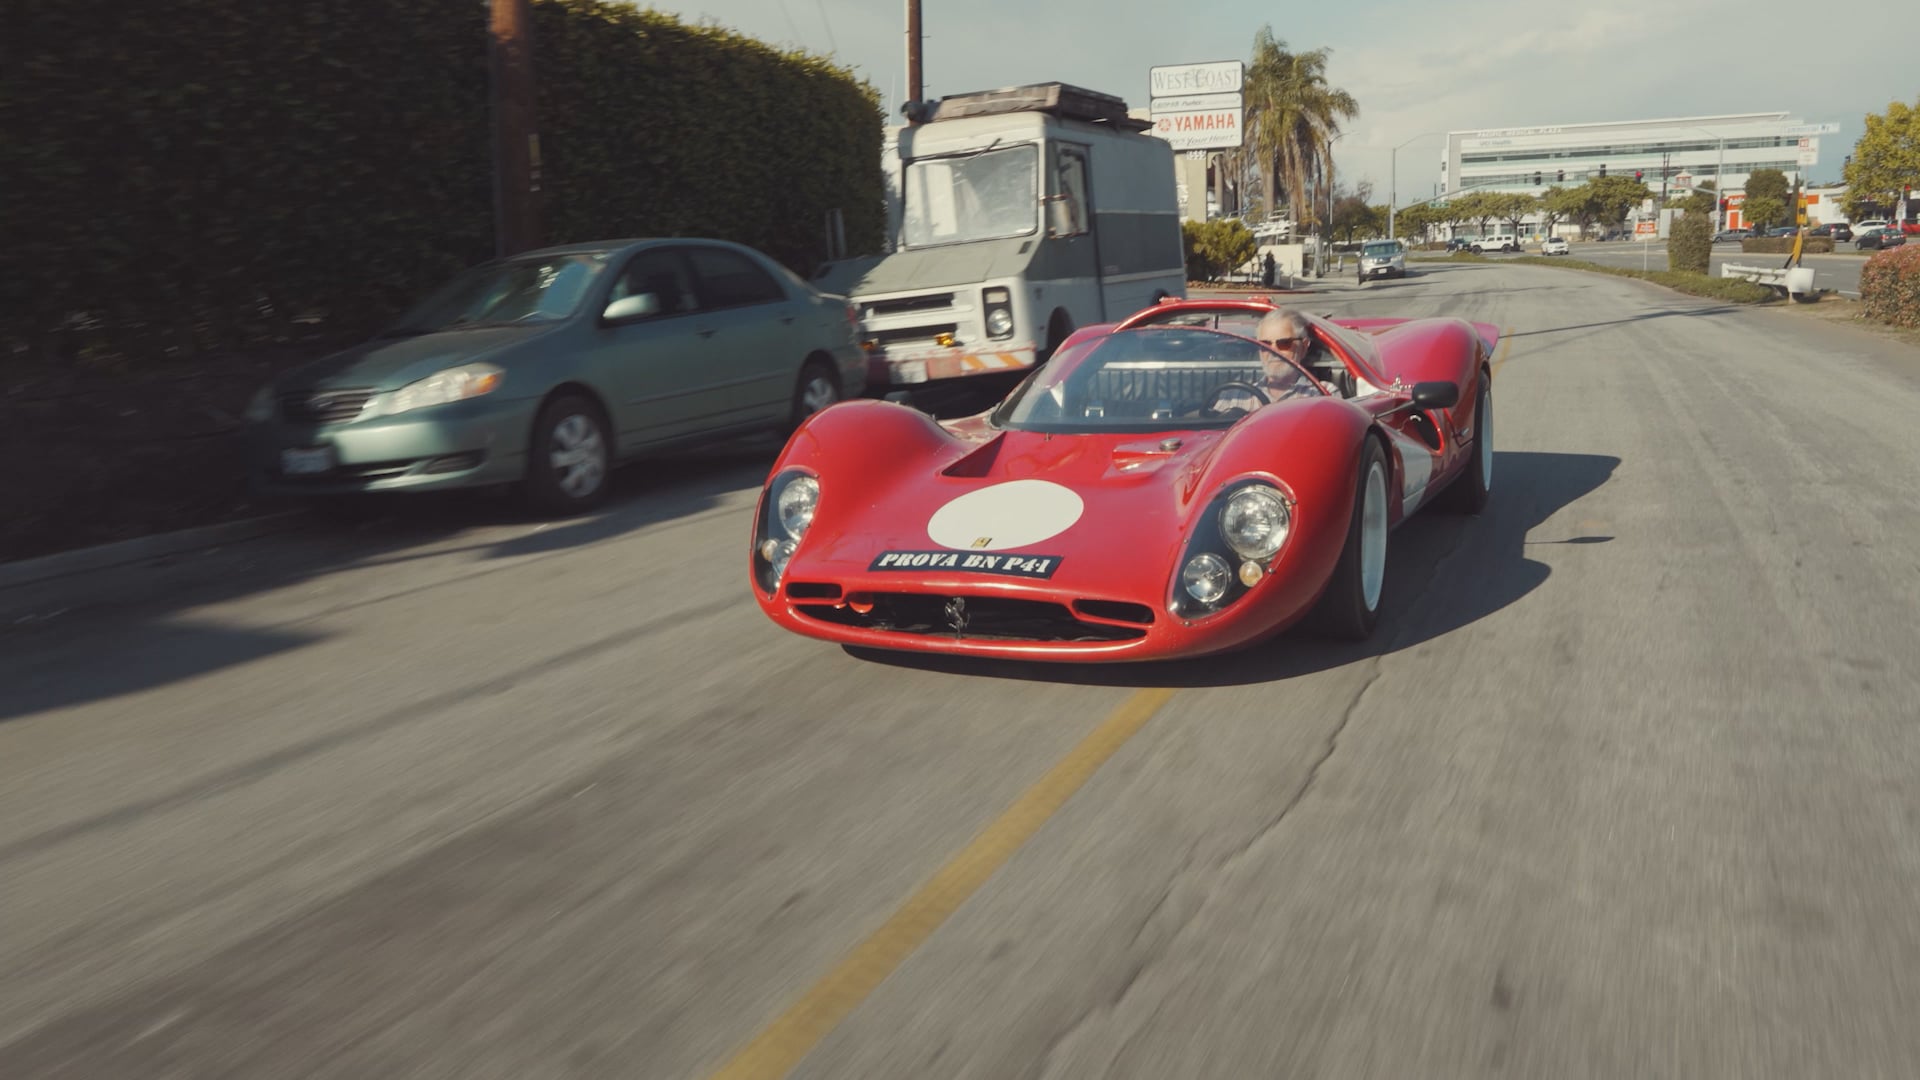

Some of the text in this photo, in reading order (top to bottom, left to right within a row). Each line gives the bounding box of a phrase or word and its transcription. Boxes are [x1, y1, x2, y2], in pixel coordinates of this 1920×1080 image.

[1153, 68, 1239, 90] WEST COAST
[1174, 113, 1236, 132] YAMAHA
[877, 553, 959, 567] PROVA
[961, 554, 999, 569] BN
